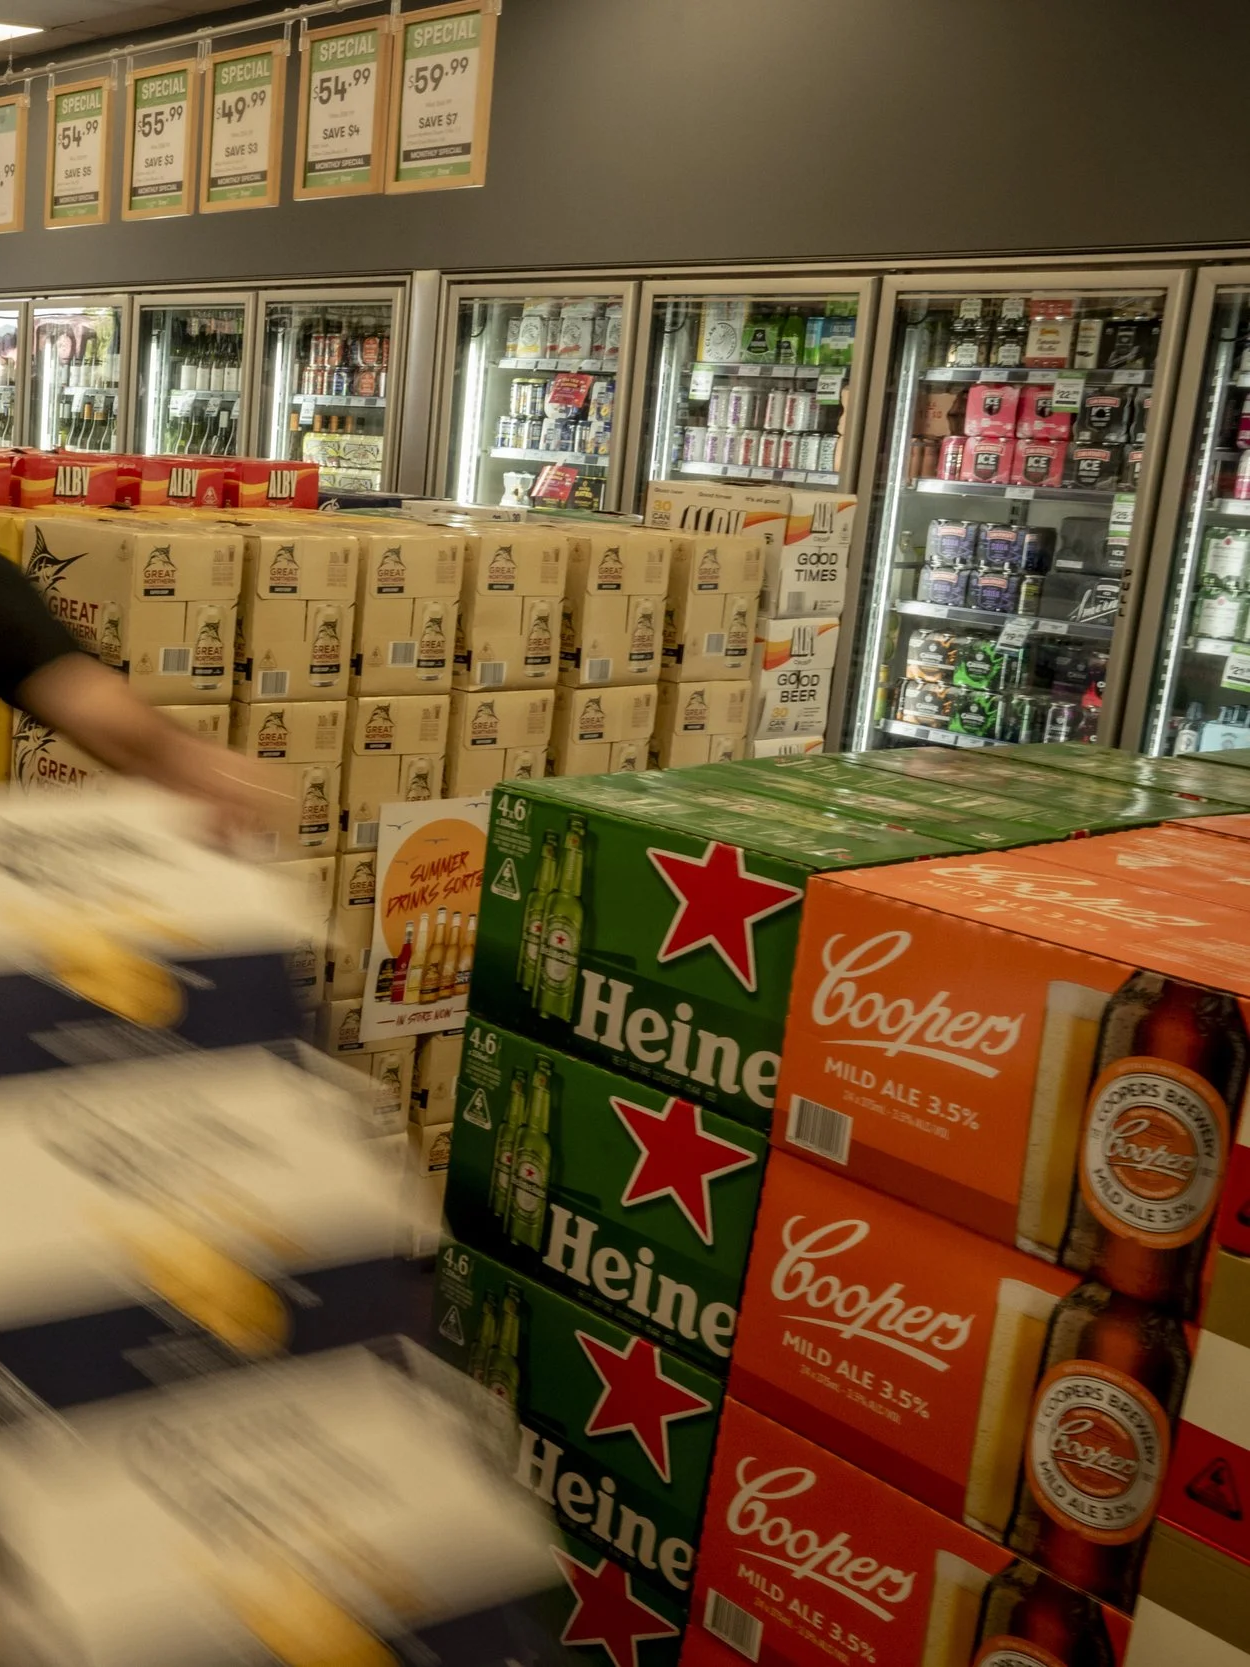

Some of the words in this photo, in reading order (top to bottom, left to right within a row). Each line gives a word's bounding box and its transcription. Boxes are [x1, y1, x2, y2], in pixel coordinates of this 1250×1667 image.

[414, 18, 476, 49] SPECIAL
[320, 35, 375, 62] SPECIAL
[221, 59, 270, 85] SPECIAL
[408, 56, 469, 94] $59.99
[142, 76, 186, 100] SPECIAL
[313, 67, 371, 105] $54.99
[62, 93, 101, 114] SPECIAL
[216, 90, 266, 124] $49.99
[138, 105, 183, 138] $55.99
[418, 115, 443, 129] SAVE
[446, 113, 458, 126] $7
[58, 120, 99, 150] $54.99
[322, 126, 346, 140] SAVE
[348, 124, 360, 138] $4
[225, 145, 245, 157] SAVE
[410, 150, 437, 159] MONTHLY
[438, 146, 463, 156] SPECIAL
[145, 157, 162, 168] SAVE
[315, 160, 341, 170] MONTHLY
[342, 157, 364, 167] SPECIAL
[65, 168, 80, 179] SAVE
[217, 175, 240, 185] MONTHLY
[241, 172, 262, 182] SPECIAL
[977, 454, 997, 465] ICE
[1027, 457, 1048, 467] ICE
[1079, 460, 1100, 471] ICE
[54, 466, 90, 498] ALBY
[167, 467, 200, 499] ALBY
[266, 470, 298, 500] ALBY
[653, 500, 673, 511] 30
[652, 513, 670, 521] CAN
[798, 553, 839, 567] GOOD
[144, 569, 176, 579] GREAT
[270, 568, 298, 576] GREAT
[378, 568, 405, 577] GREAT
[488, 566, 516, 575] GREAT
[598, 566, 623, 575] GREAT
[699, 567, 720, 575] GREAT
[795, 569, 838, 582] TIMES
[49, 596, 99, 624] GREAT
[196, 646, 223, 656] GREAT
[314, 644, 340, 653] GREAT
[421, 640, 446, 649] GREAT
[528, 638, 551, 646] GREAT
[778, 672, 820, 688] GOOD
[780, 689, 817, 703] BEER
[366, 726, 394, 734] GREAT
[472, 721, 498, 729] GREAT
[579, 716, 604, 725] GREAT
[259, 733, 287, 741] GREAT
[37, 757, 87, 789] GREAT
[302, 804, 329, 814] GREAT
[410, 851, 469, 887] SUMMER
[386, 882, 440, 918] DRINKS
[812, 930, 1026, 1079] Coopers
[396, 1014, 407, 1026] IN
[408, 1011, 433, 1024] STORE
[434, 1007, 453, 1020] NOW
[573, 969, 782, 1108] Heine
[824, 1056, 877, 1090] MILD
[880, 1080, 923, 1108] ALE
[926, 1095, 981, 1131] 3.5%
[1099, 1083, 1161, 1122] COOPERS
[1165, 1088, 1216, 1159] BREWERY
[1106, 1119, 1198, 1181] Coopers
[1093, 1168, 1125, 1205] MILD
[1124, 1204, 1156, 1222] ALE
[542, 1203, 738, 1358] Heine
[771, 1215, 977, 1372] Coopers
[782, 1331, 832, 1367] MILD
[836, 1360, 875, 1390] ALE
[879, 1380, 931, 1420] 3.5%
[1044, 1385, 1104, 1418] COOPERS
[1108, 1394, 1156, 1465] BREWERY
[1051, 1419, 1139, 1483] Coopers
[1040, 1461, 1067, 1498] MILD
[1068, 1500, 1098, 1518] ALE
[513, 1424, 694, 1591] Heine
[726, 1456, 918, 1623] Coopers
[737, 1565, 785, 1603] MILD
[788, 1599, 824, 1631] ALE
[829, 1623, 877, 1665] 3.5%
